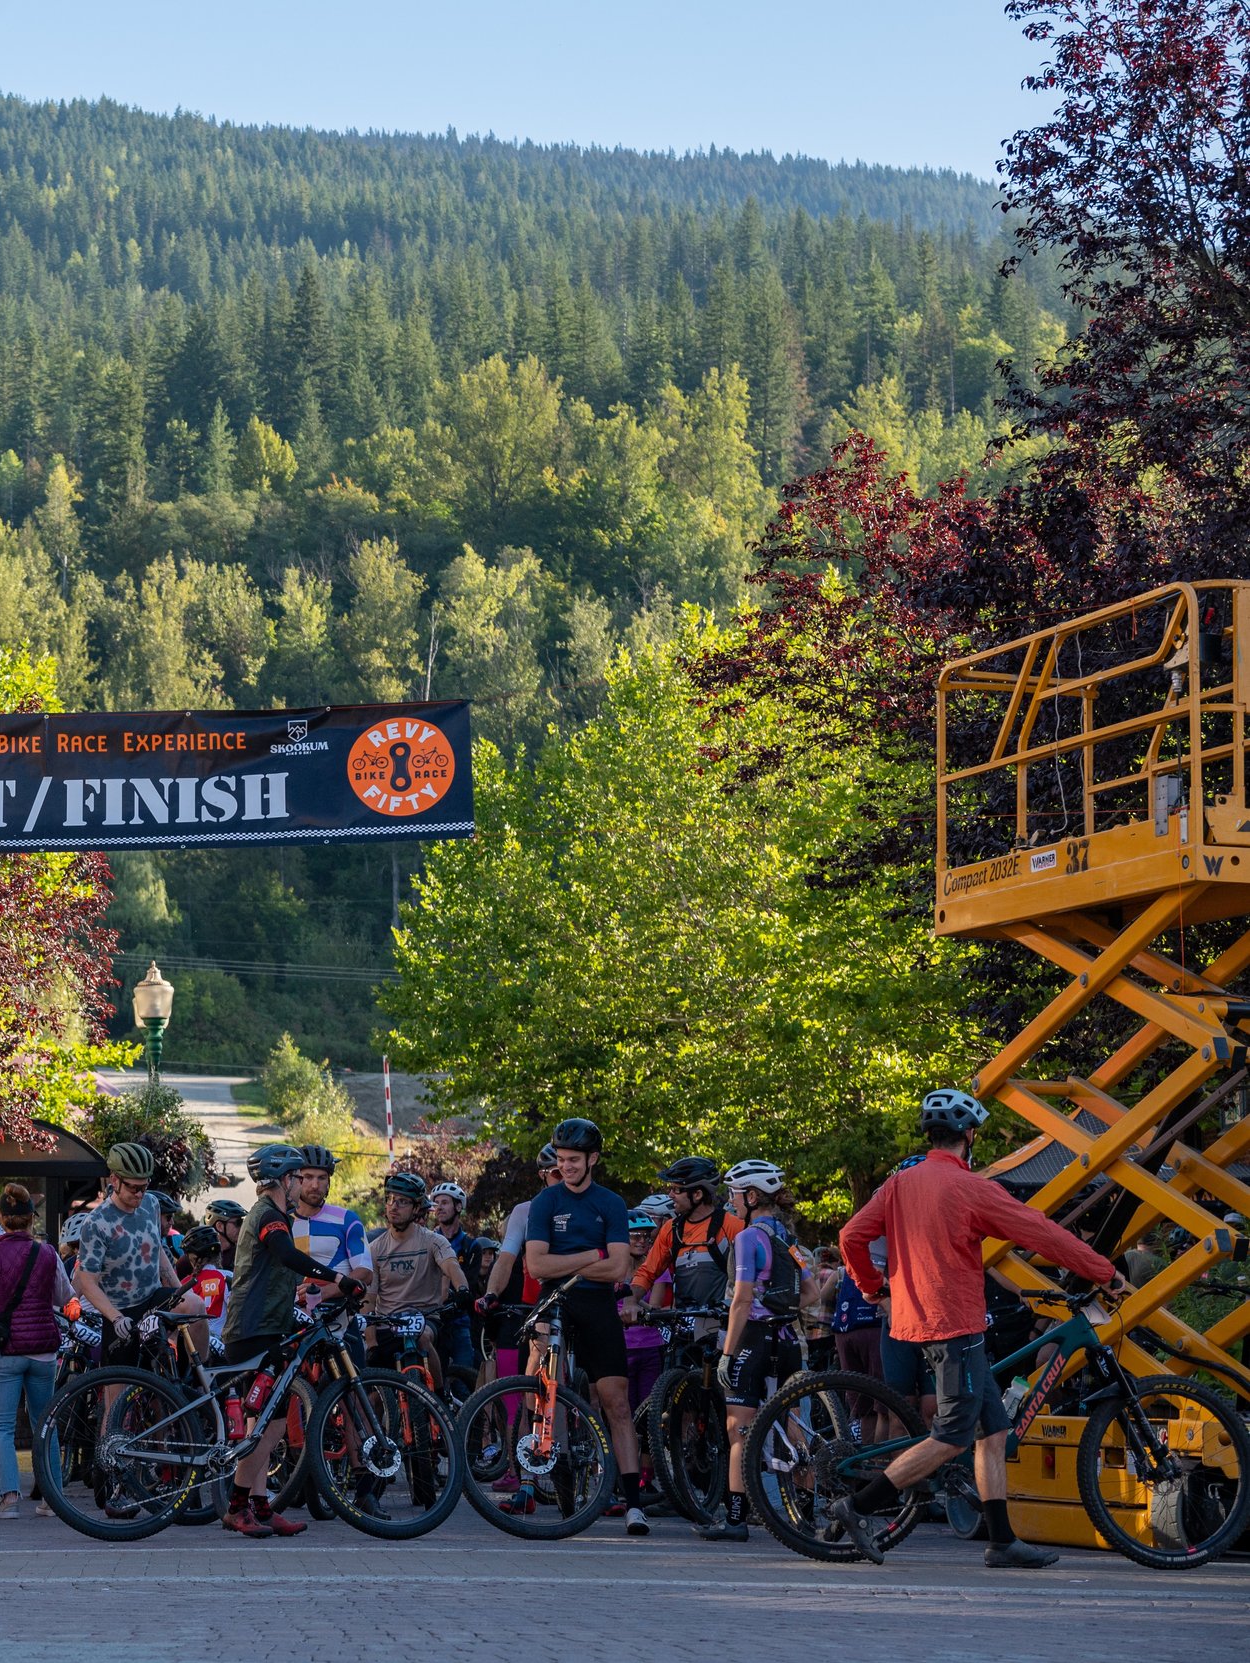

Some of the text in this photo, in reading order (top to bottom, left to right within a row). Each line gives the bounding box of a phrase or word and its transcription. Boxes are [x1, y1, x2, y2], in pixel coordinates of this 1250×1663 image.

[57, 733, 108, 753] RACE
[124, 732, 247, 752] EXPERIENCE
[367, 722, 436, 748] REVY
[270, 741, 329, 753] SKOOKUM
[355, 772, 386, 781] BIKE
[414, 769, 447, 779] RACE
[362, 782, 438, 812] FIFTY
[1066, 839, 1090, 875] 37
[943, 855, 1021, 897] Compact 2032E
[390, 1260, 415, 1274] FOX
[205, 1282, 217, 1293] 50
[77, 1327, 101, 1346] 010
[250, 1385, 262, 1403] CLIF
[1014, 1353, 1067, 1440] SANTA CRUZ
[173, 1470, 197, 1509] MAXXIS
[730, 1495, 742, 1521] SMITH
